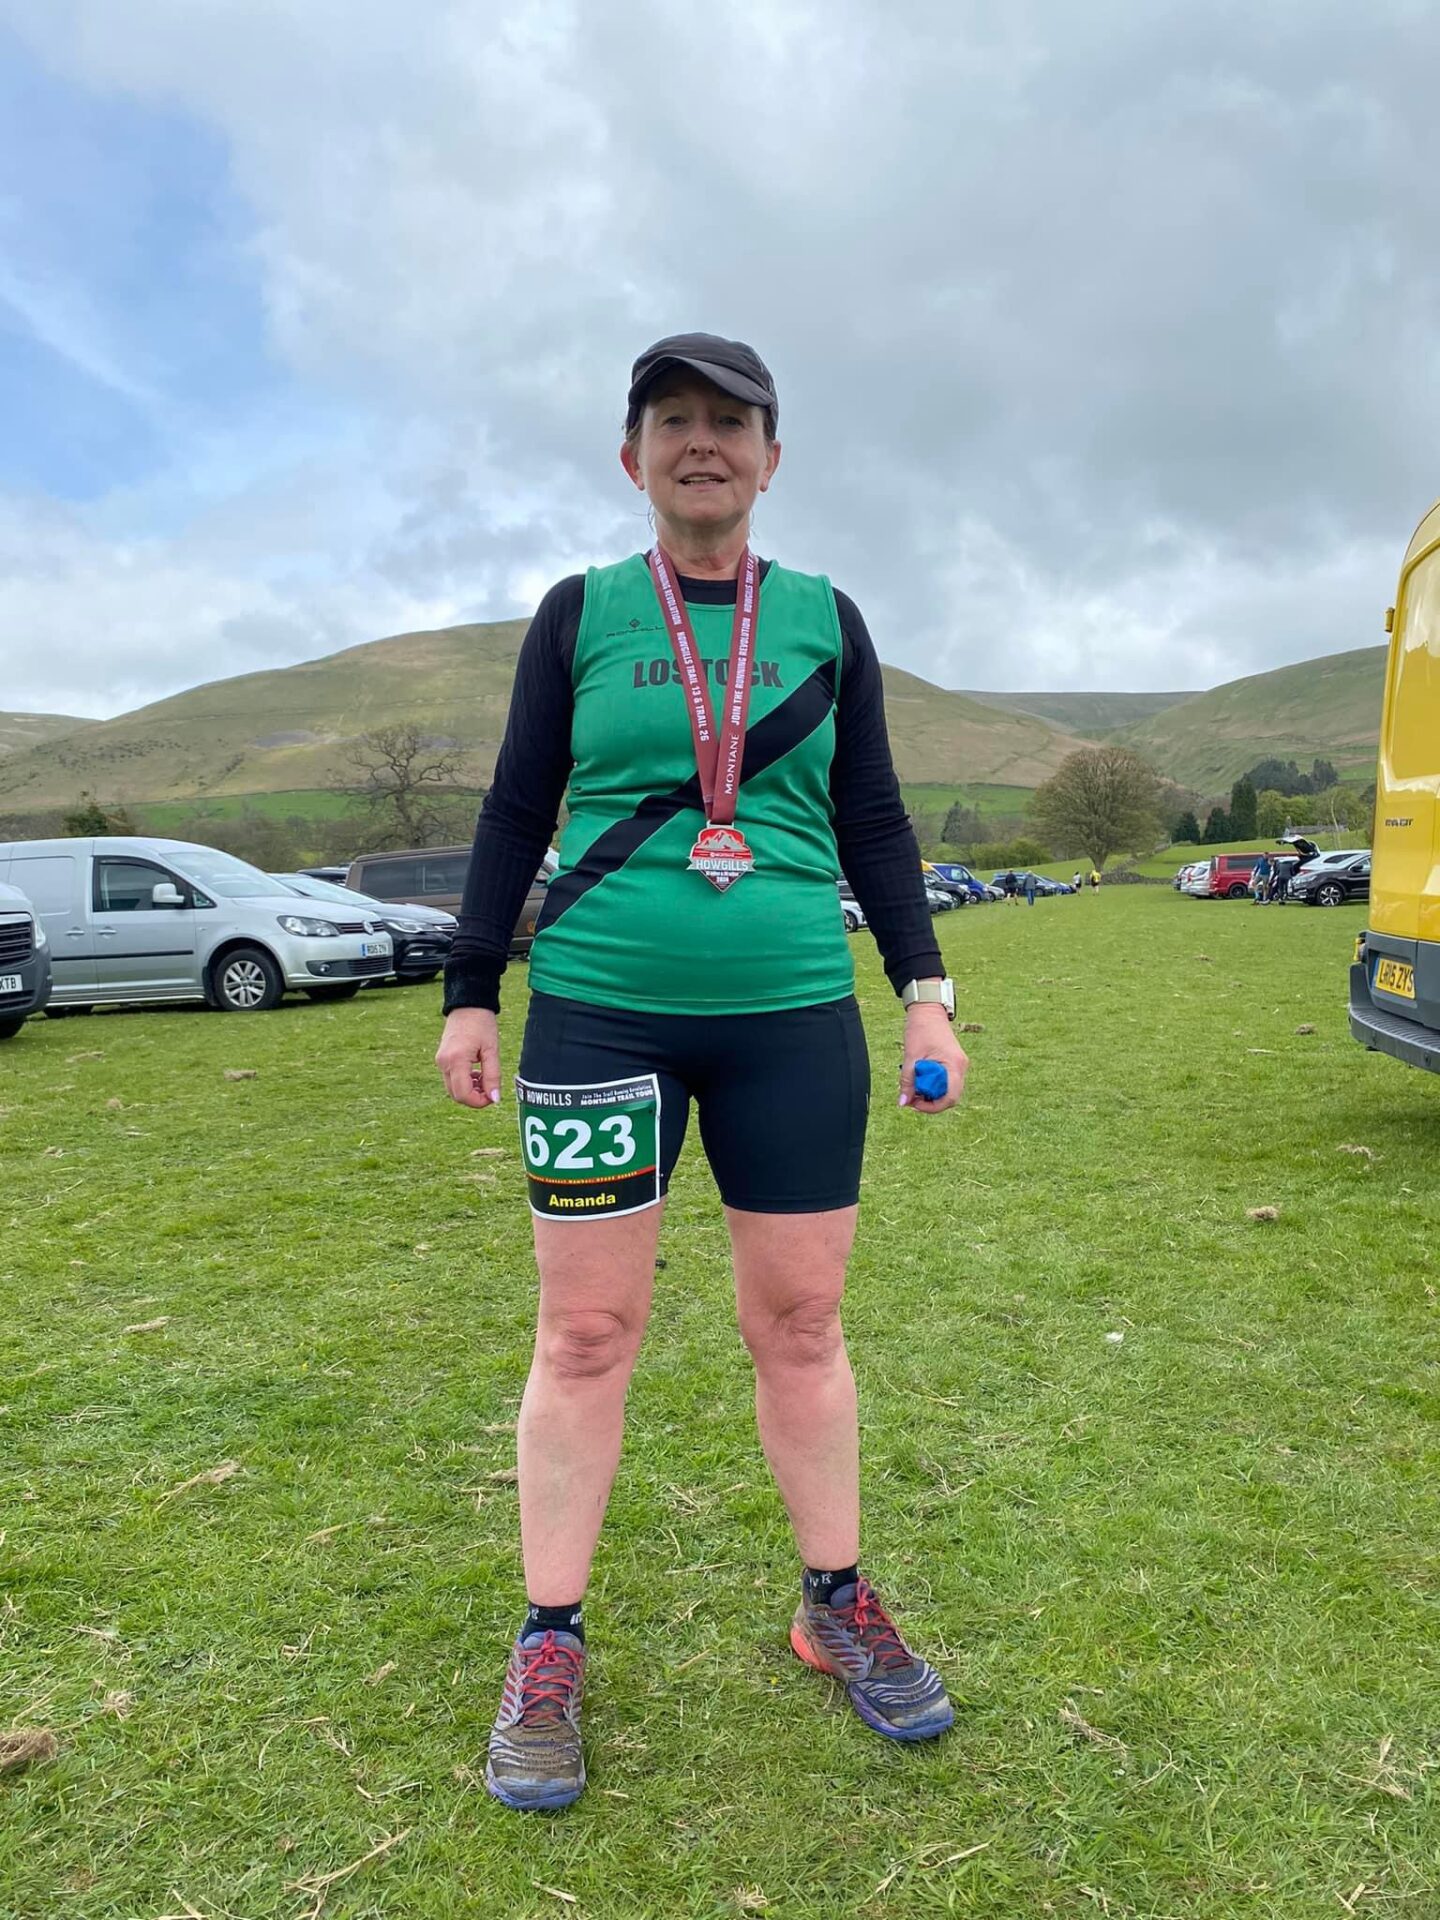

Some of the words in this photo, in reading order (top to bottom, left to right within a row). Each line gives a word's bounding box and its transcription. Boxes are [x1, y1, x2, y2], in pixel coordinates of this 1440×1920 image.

[664, 588, 682, 625] REVOLUTION
[739, 617, 751, 656] REVOLUTION
[676, 631, 693, 665] HOWGILLS
[686, 666, 698, 685] TRAIL
[735, 657, 747, 689] RUNNING
[692, 686, 702, 696] 13
[733, 689, 743, 704] THE
[695, 705, 707, 728] TRAIL
[731, 705, 741, 726] JOIN
[699, 729, 710, 742] 26
[724, 733, 740, 795] MONTANE
[696, 859, 749, 872] HOWGILLS
[526, 1089, 572, 1106] HOWGILLS
[580, 1096, 617, 1106] MONTANE
[617, 1093, 635, 1102] TRAIL
[635, 1089, 654, 1098] TOUR
[525, 1114, 637, 1169] 623
[548, 1192, 617, 1208] Amanda
